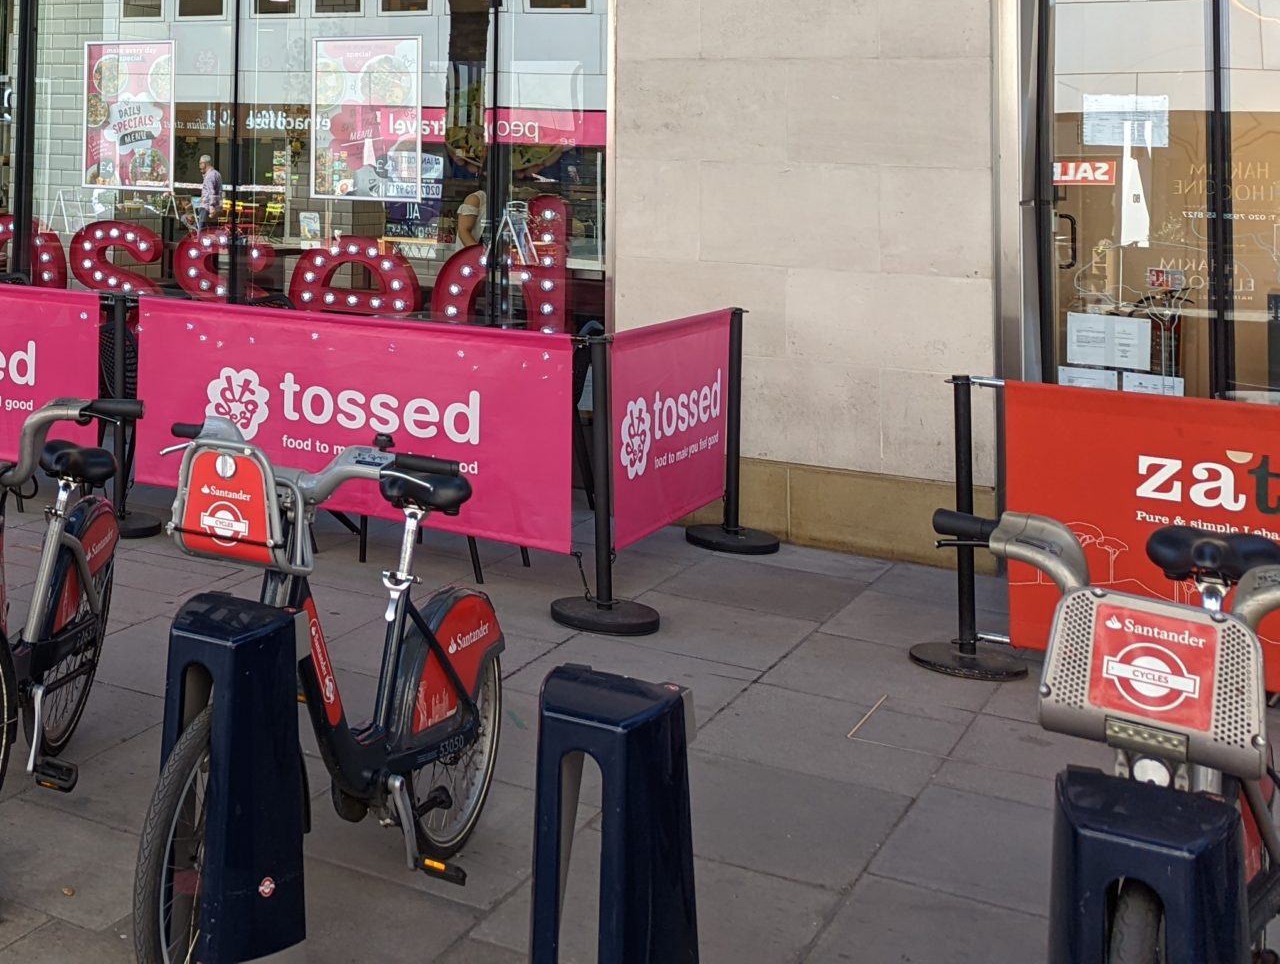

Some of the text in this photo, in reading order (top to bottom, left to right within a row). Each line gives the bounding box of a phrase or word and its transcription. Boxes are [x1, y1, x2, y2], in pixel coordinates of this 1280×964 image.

[118, 105, 141, 118] DAILY
[113, 115, 154, 134] SPECIALS
[125, 131, 146, 144] MENU
[100, 162, 114, 174] £4
[5, 398, 34, 411] good
[280, 372, 481, 445] tossed
[653, 368, 721, 440] tossed
[282, 434, 311, 451] food
[315, 438, 330, 454] to
[668, 453, 675, 464] to
[210, 485, 252, 501] Santander
[215, 519, 234, 528] CYCLES
[1136, 510, 1169, 525] Pure
[1173, 515, 1186, 526] &
[1190, 518, 1239, 534] simple
[456, 620, 489, 651] Santander
[1123, 618, 1207, 648] Santander
[1132, 669, 1169, 685] CYCLES
[440, 734, 465, 756] 53050
